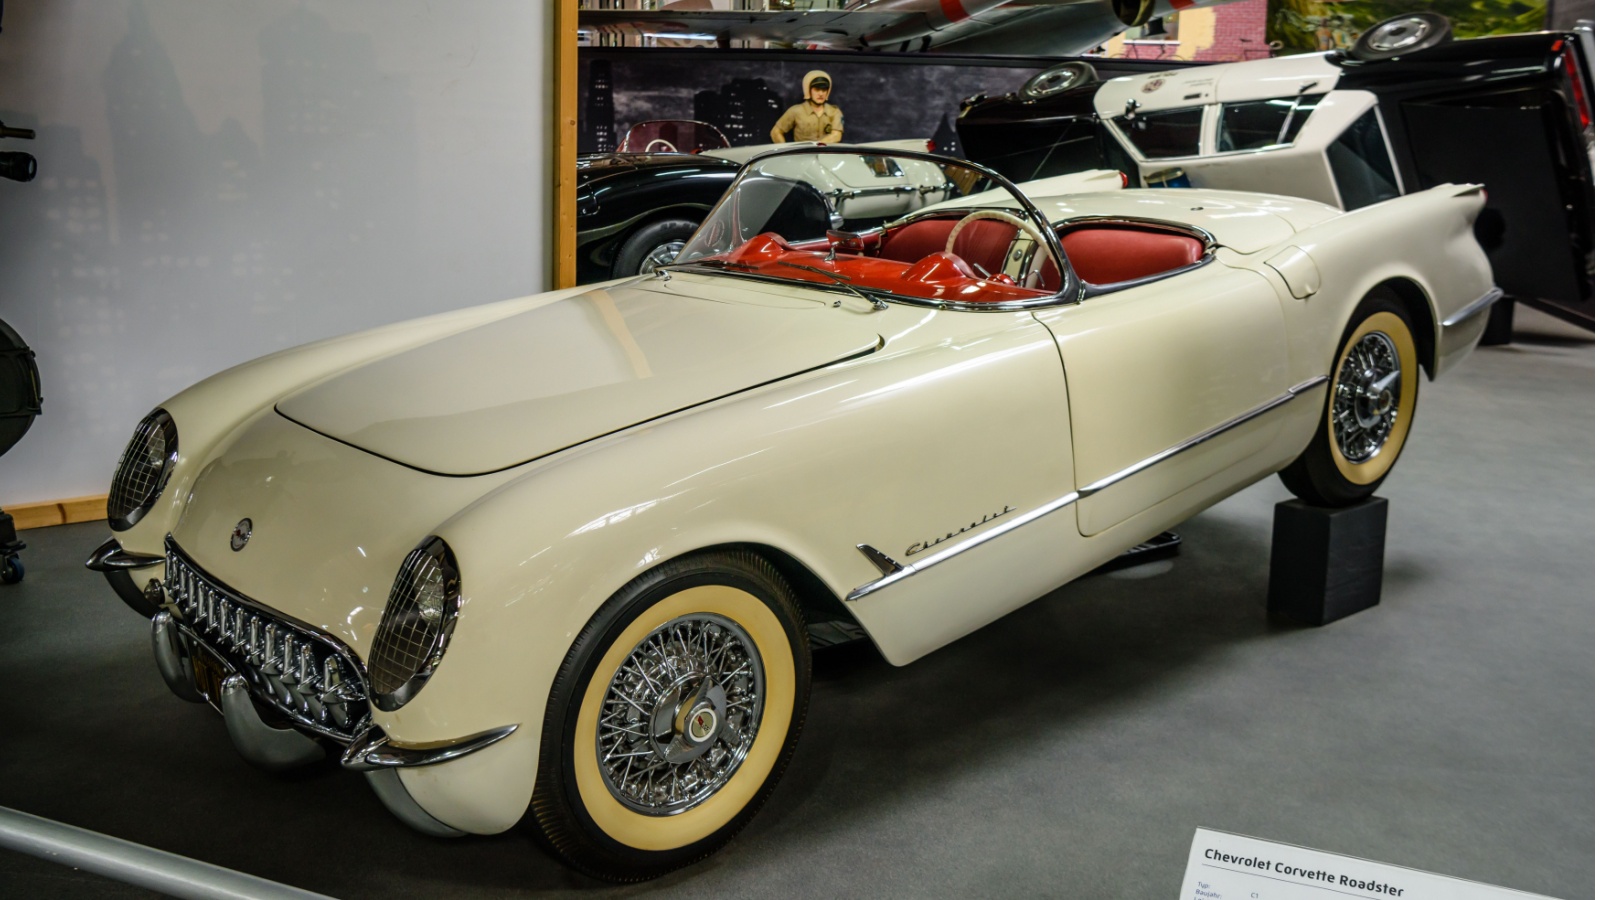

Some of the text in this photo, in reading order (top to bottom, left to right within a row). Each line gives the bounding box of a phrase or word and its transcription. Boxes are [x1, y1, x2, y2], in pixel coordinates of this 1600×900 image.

[1204, 848, 1404, 897] Chevrolet Corvette Roadster
